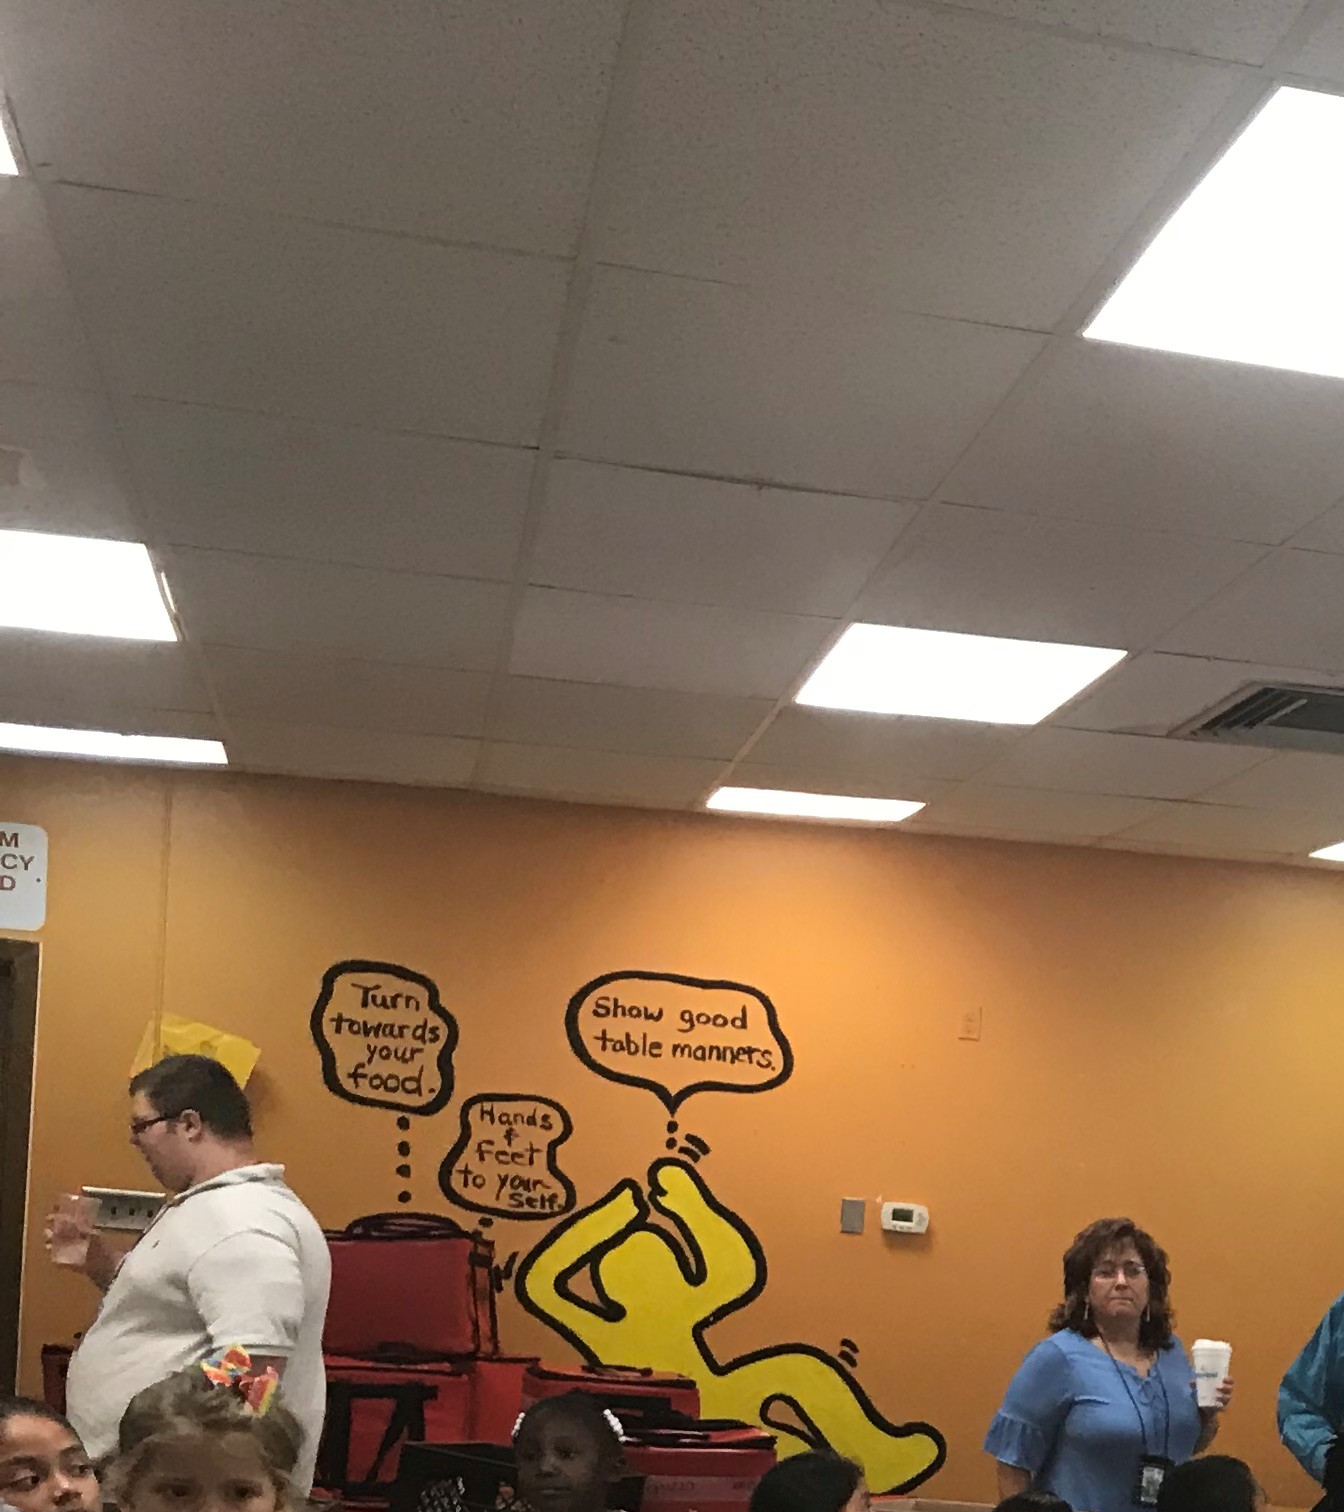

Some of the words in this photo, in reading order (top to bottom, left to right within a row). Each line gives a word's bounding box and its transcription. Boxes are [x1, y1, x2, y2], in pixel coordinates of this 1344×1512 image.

[351, 983, 420, 1011] Turn
[329, 1012, 440, 1045] towards
[592, 996, 664, 1023] Show
[677, 1004, 748, 1033] good
[366, 1043, 424, 1064] your
[593, 1028, 663, 1058] table
[671, 1042, 776, 1071] manners.
[347, 1063, 437, 1097] food.
[479, 1102, 553, 1131] Hands
[456, 1163, 487, 1189] to
[496, 1172, 552, 1201] your
